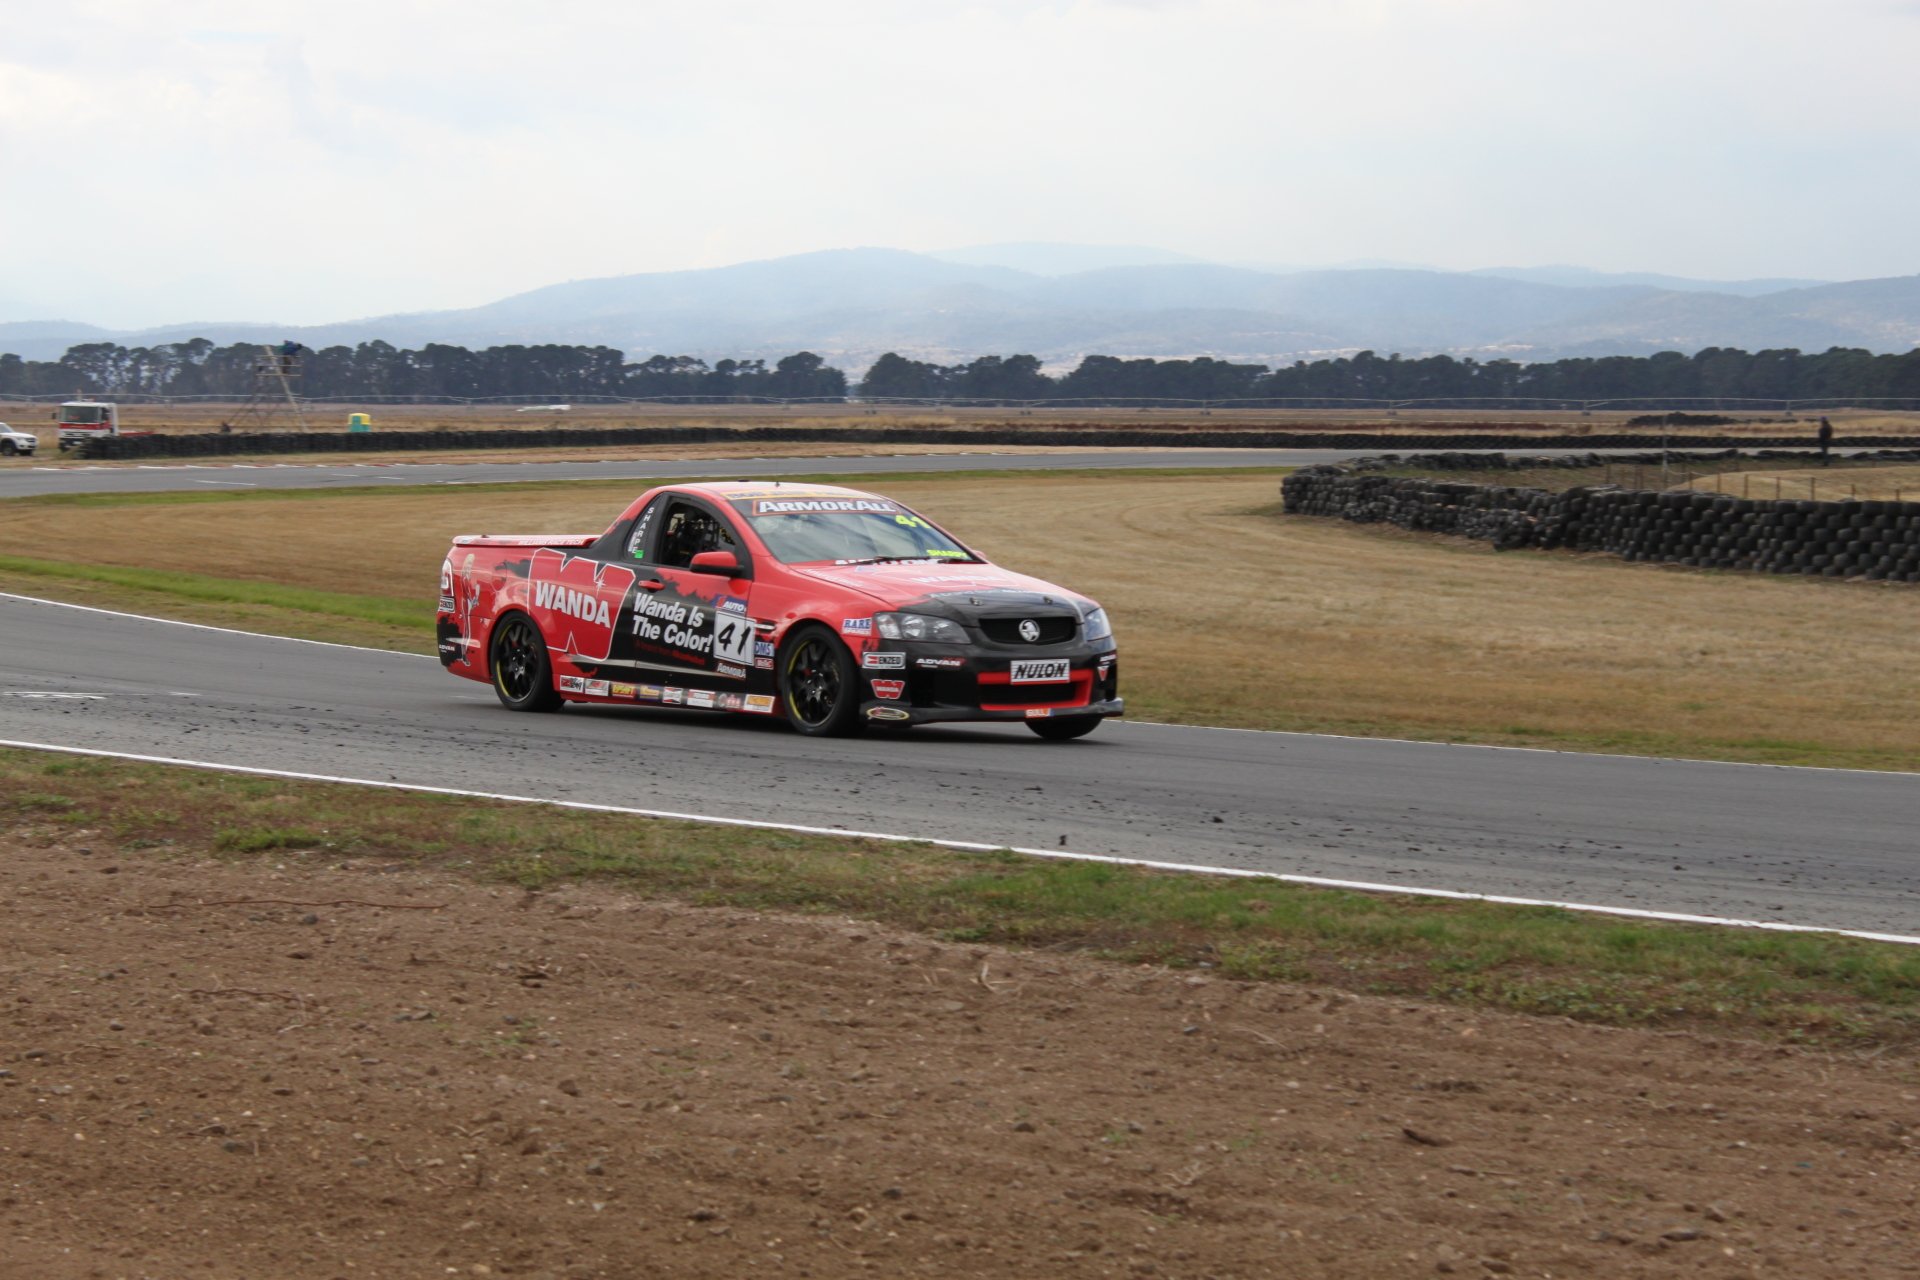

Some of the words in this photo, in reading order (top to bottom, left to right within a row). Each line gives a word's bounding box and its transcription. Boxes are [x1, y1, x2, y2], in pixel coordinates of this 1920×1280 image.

[895, 514, 932, 529] 41
[535, 580, 611, 629] WANDA
[633, 592, 684, 624] Wanda
[687, 606, 705, 628] Is
[632, 614, 661, 640] The
[663, 624, 714, 653] Color!
[718, 622, 752, 656] 41
[1014, 662, 1067, 679] NULON
